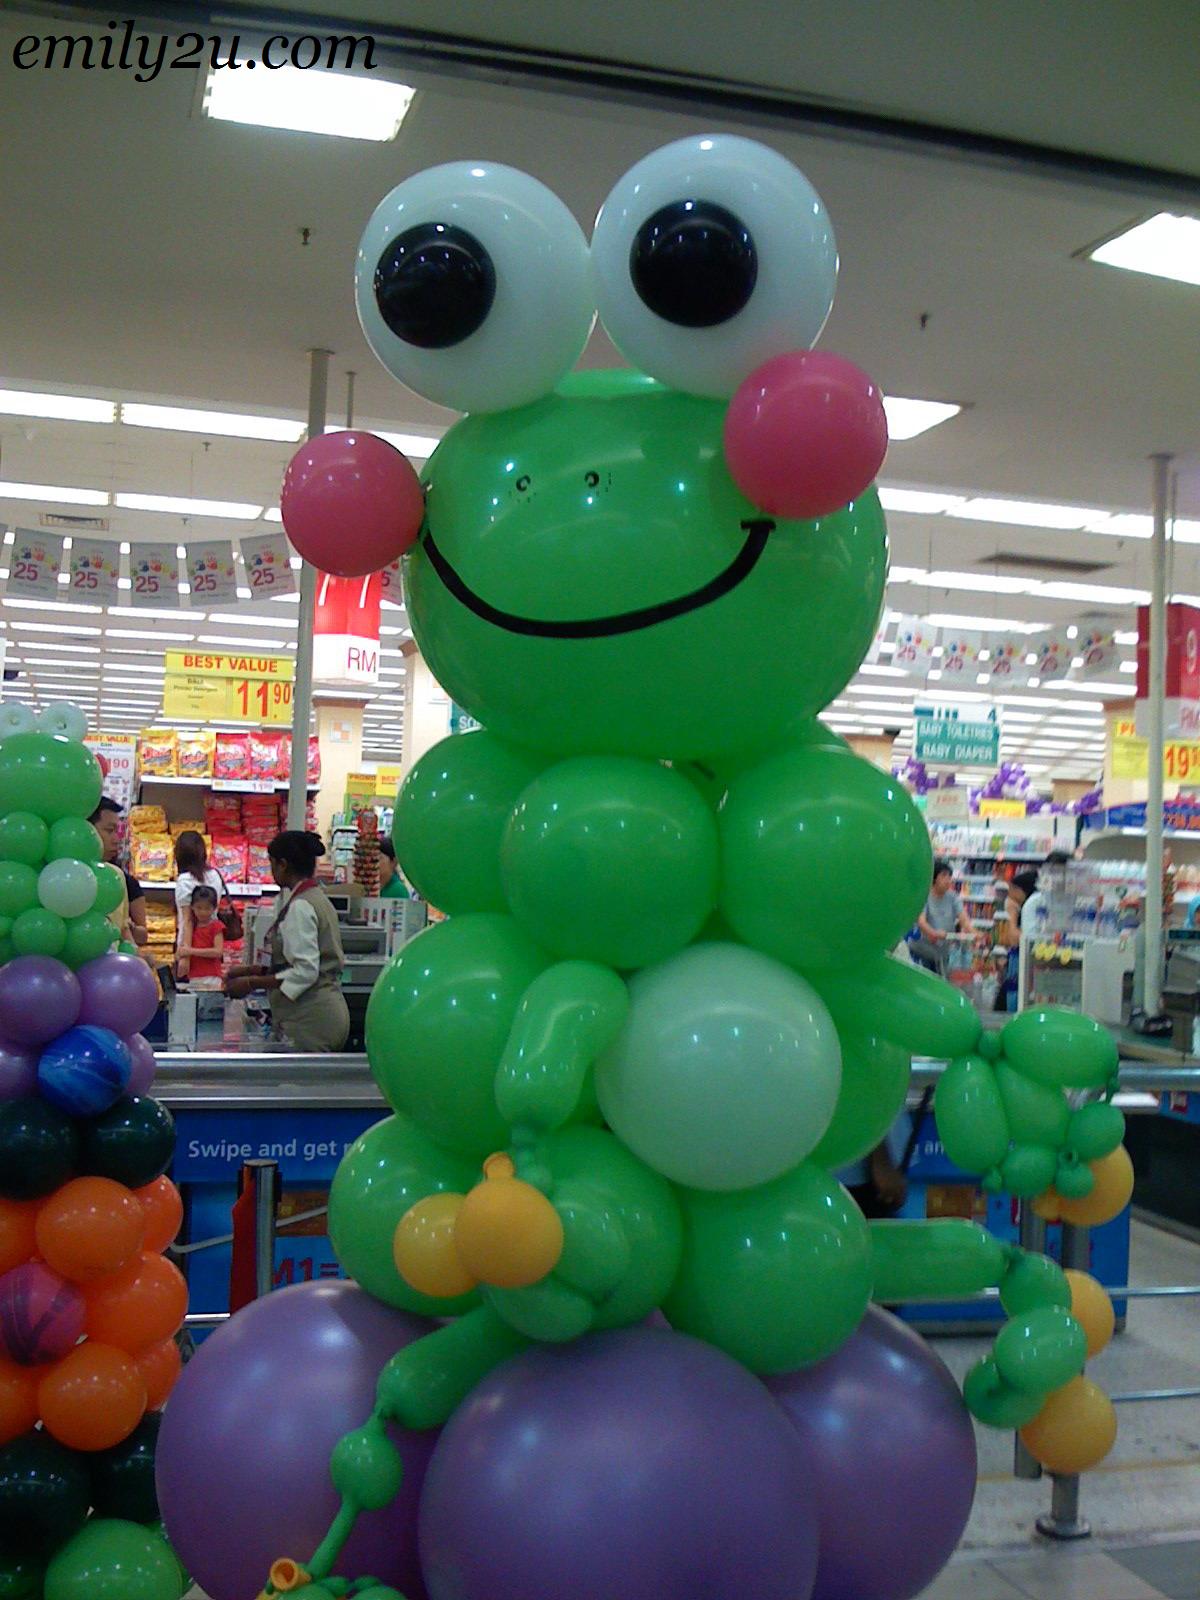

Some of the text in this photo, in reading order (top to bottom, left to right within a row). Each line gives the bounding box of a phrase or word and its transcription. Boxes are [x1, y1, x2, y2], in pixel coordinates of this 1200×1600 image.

[13, 562, 38, 581] 25
[74, 571, 98, 589] 25
[251, 568, 275, 587] 25
[135, 576, 159, 593] 25
[194, 574, 217, 592] 25
[183, 654, 278, 673] BEST VALUE
[347, 647, 376, 673] RM
[922, 743, 951, 758] BABY
[188, 1139, 252, 1162] Swipe
[258, 1138, 297, 1158] and
[303, 1140, 337, 1160] get
